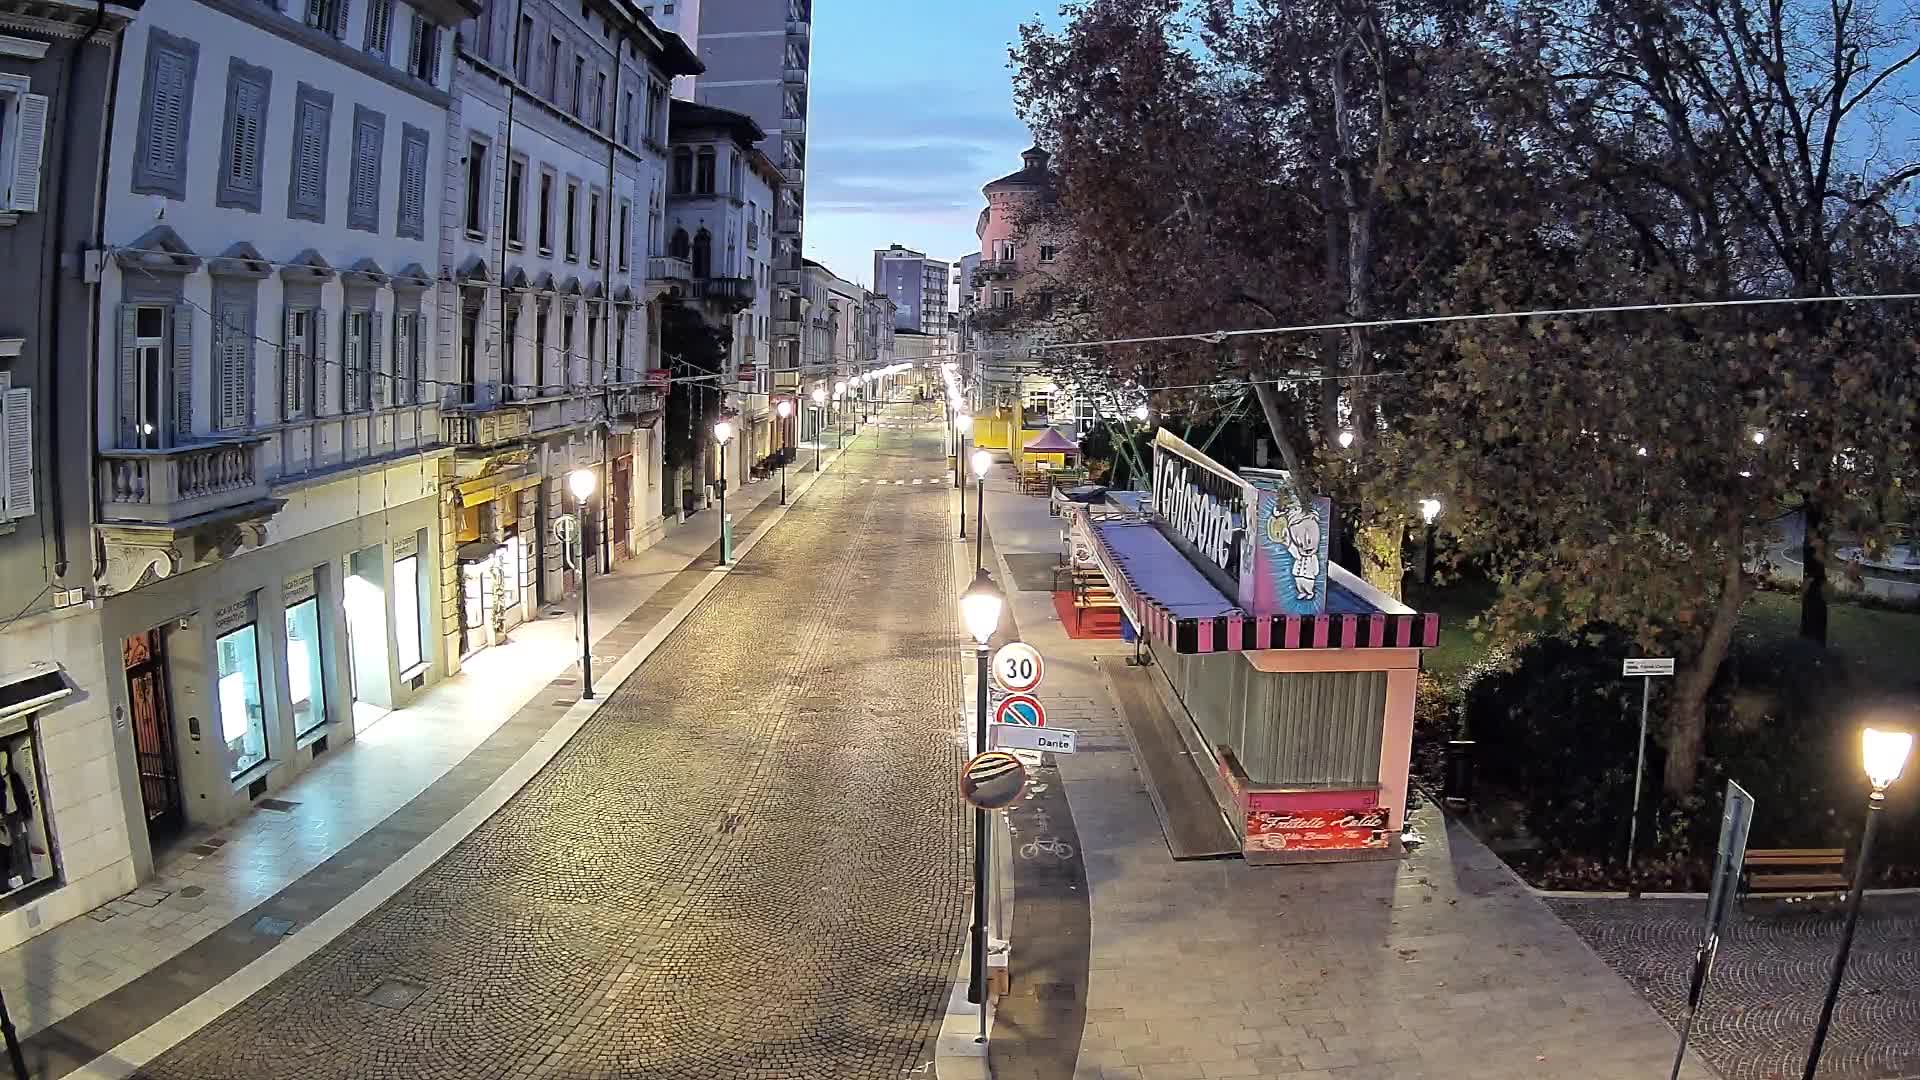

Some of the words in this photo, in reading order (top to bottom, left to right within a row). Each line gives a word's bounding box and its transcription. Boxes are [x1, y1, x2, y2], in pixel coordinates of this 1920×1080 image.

[1163, 458, 1233, 569] Golosone
[1006, 658, 1032, 679] 30
[1038, 737, 1069, 749] Dante
